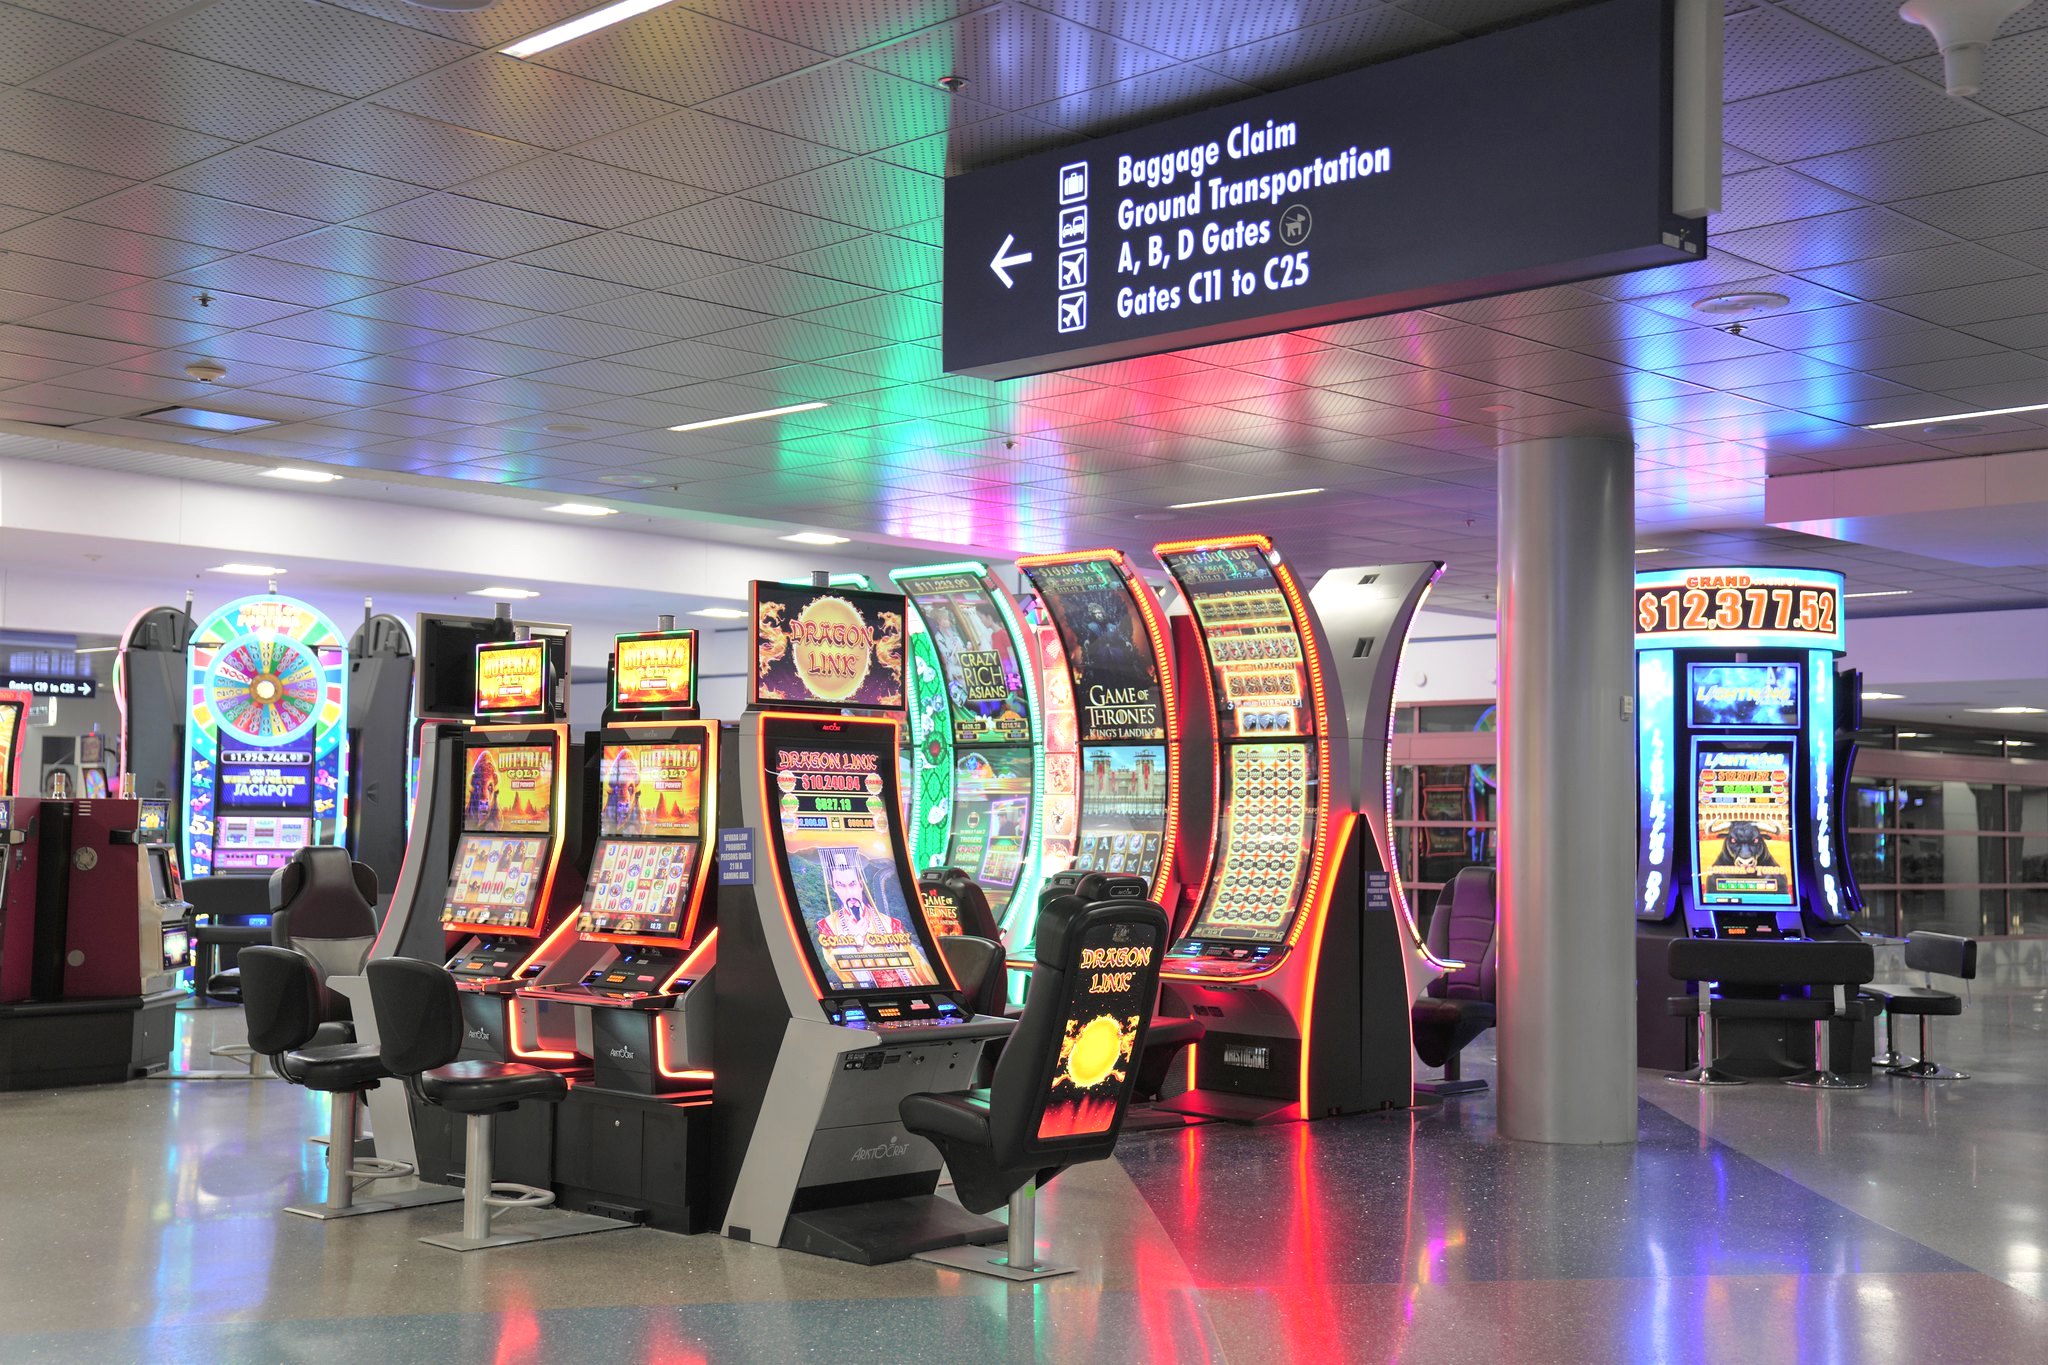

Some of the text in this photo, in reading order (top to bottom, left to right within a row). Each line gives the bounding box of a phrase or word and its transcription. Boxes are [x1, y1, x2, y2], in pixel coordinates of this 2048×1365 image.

[1118, 120, 1296, 188] Baggage Claim
[1118, 146, 1390, 230] Ground Transportation
[1118, 219, 1270, 276] A, B, D Gates
[1117, 252, 1310, 319] Gates C11 to C25
[1249, 587, 1279, 595] JACKPOT
[1685, 576, 1751, 589] GRAND
[1639, 589, 1834, 632] $12,377.52
[789, 619, 874, 649] DRAGON
[808, 652, 856, 678] LINK
[960, 652, 997, 667] CRAZY
[963, 667, 1005, 687] RICH
[50, 684, 59, 693] to
[968, 686, 1006, 699] ASIANS
[1089, 685, 1149, 706] GAME OF
[1696, 685, 1791, 704] LIGHTNING
[1089, 706, 1155, 728] THRONES
[1089, 728, 1156, 738] KING'S LANDING
[778, 750, 877, 771] DRAGON LINK
[507, 769, 541, 780] GOLD
[801, 773, 861, 791] $10,240.84
[233, 785, 295, 797] JACKPOT
[739, 833, 748, 841] LAW
[725, 843, 746, 851] PROHIBITS
[957, 845, 983, 854] CRAZY
[721, 852, 751, 861] PERSONS UNDER
[723, 872, 738, 880] GAMING
[480, 881, 492, 895] 10
[492, 881, 504, 896] 10
[817, 932, 912, 948] GOLDE CENTURY
[1080, 945, 1153, 969] DRAGON
[1089, 971, 1133, 993] LINK
